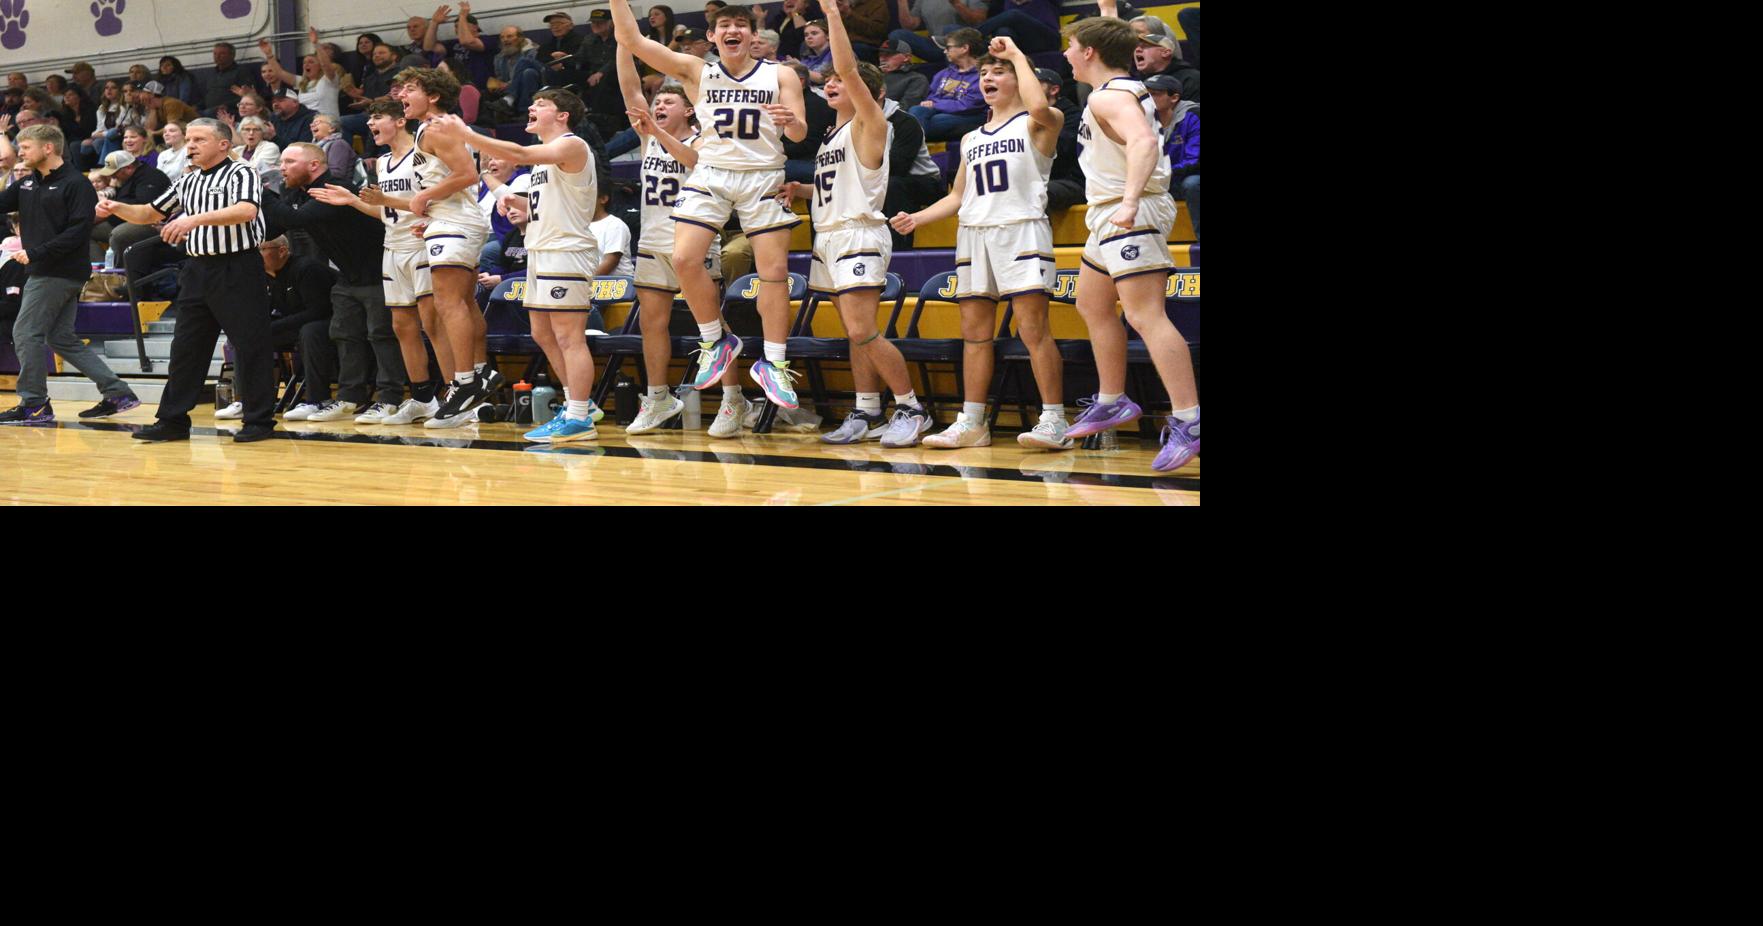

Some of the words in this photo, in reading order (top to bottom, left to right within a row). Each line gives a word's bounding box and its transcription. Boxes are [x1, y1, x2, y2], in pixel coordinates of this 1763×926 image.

[706, 89, 774, 105] JEFFERSON
[713, 108, 761, 140] 20
[645, 175, 680, 207] 22
[815, 170, 836, 207] 15
[973, 159, 1009, 196] 10
[384, 206, 399, 224] 4
[1166, 273, 1200, 298] JH
[519, 395, 530, 406] G
